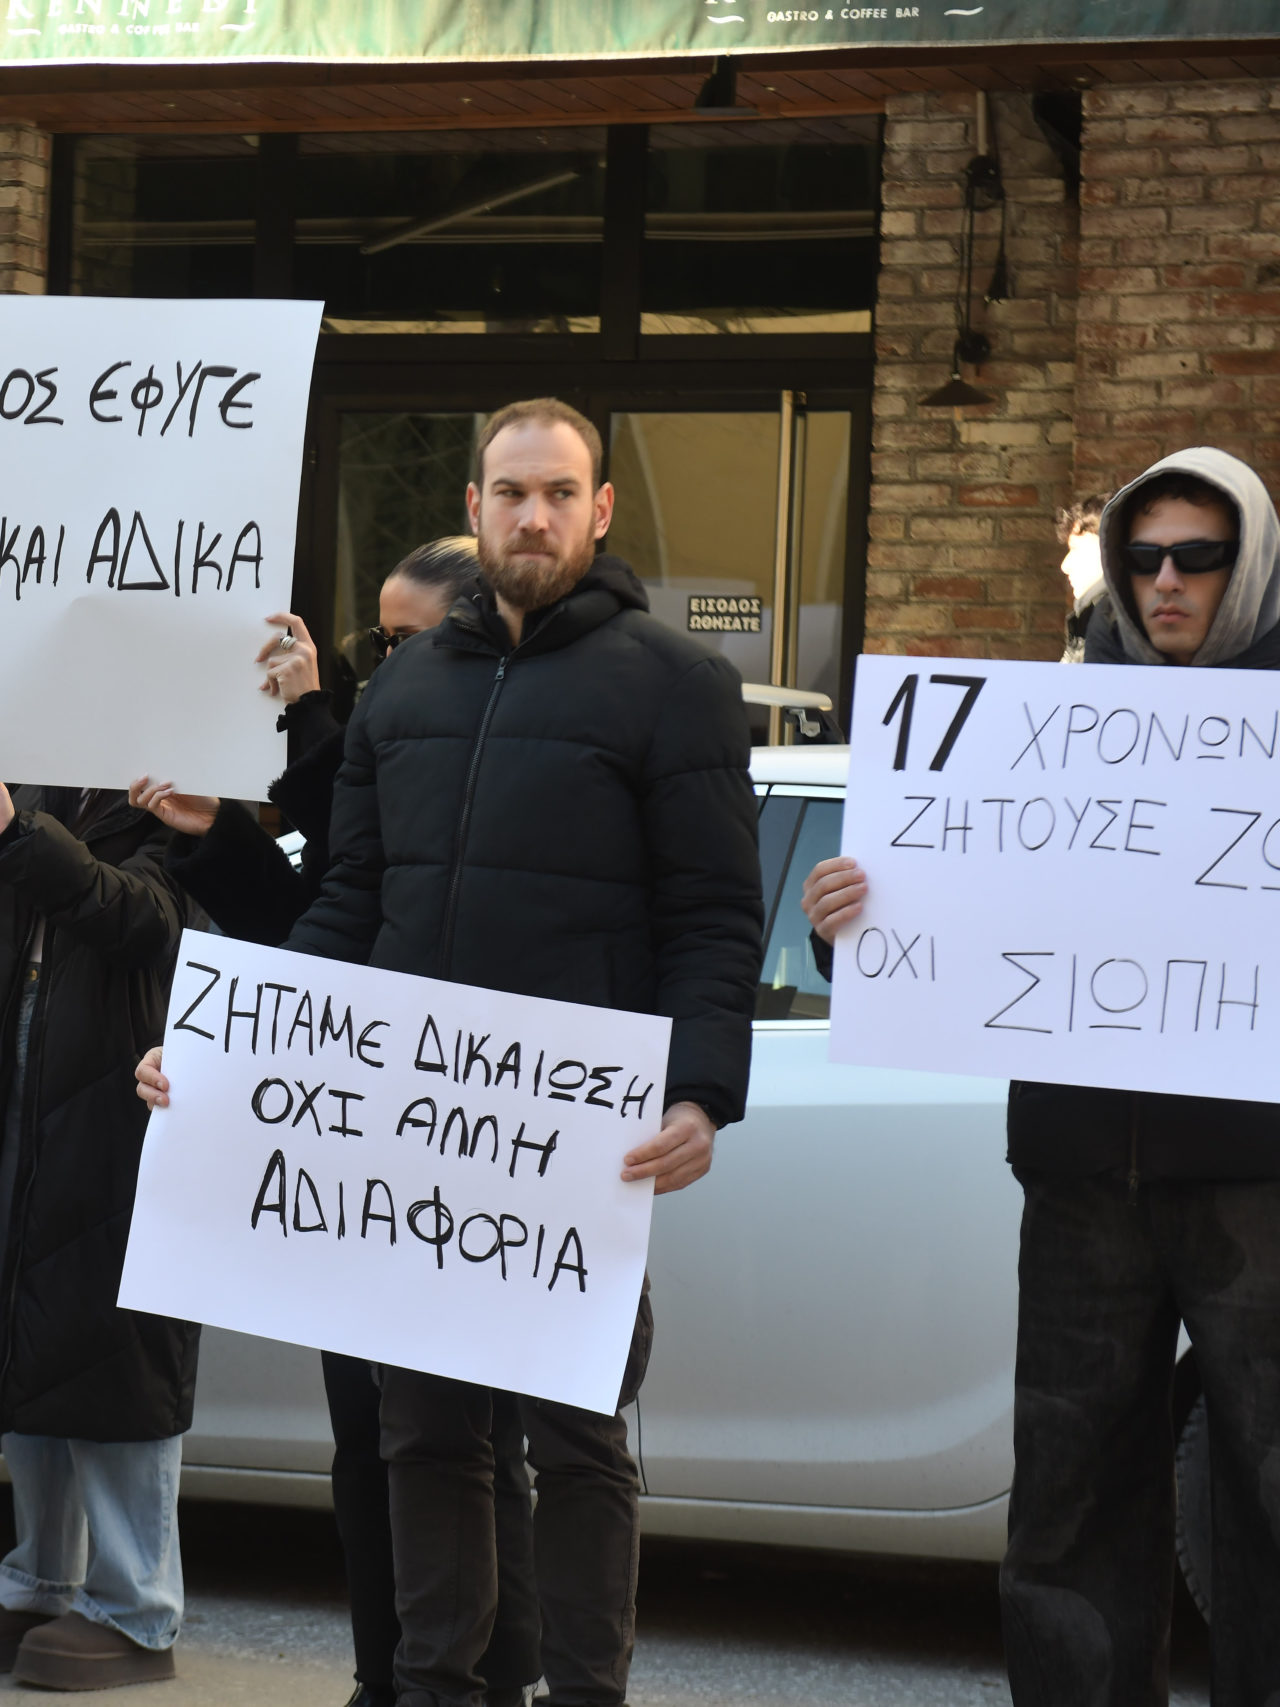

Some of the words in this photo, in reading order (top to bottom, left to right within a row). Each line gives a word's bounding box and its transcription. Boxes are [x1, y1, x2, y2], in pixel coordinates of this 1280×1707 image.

[58, 23, 106, 35] GASTRO
[767, 10, 819, 23] GASTRO
[824, 10, 834, 21] &
[840, 7, 888, 20] COFFEE
[895, 6, 920, 18] BAR
[88, 359, 262, 439] ΕΦΥΓΕ
[85, 506, 265, 598] ΑΔΙΚΑ
[690, 598, 760, 613] ΕΙΣΟΔΟΣ
[881, 673, 988, 773] 17
[1010, 702, 1279, 771] ΧΡΟΝΩΝ
[889, 795, 1168, 856] ΖΗΤΟΥΣΕ
[856, 926, 936, 982] ΟΧΙ
[983, 951, 1259, 1035] ΣΙΩΠΗ
[172, 960, 391, 1069] ΖΗΤΑΜΕ
[414, 1013, 654, 1119] ΔΙΚΑΙΩΣΗ
[250, 1077, 366, 1139] ΟΧΙ
[395, 1096, 560, 1177] ΑΛΛΗ
[250, 1148, 589, 1293] ΑΔΙΑΦΟΡΙΑ
